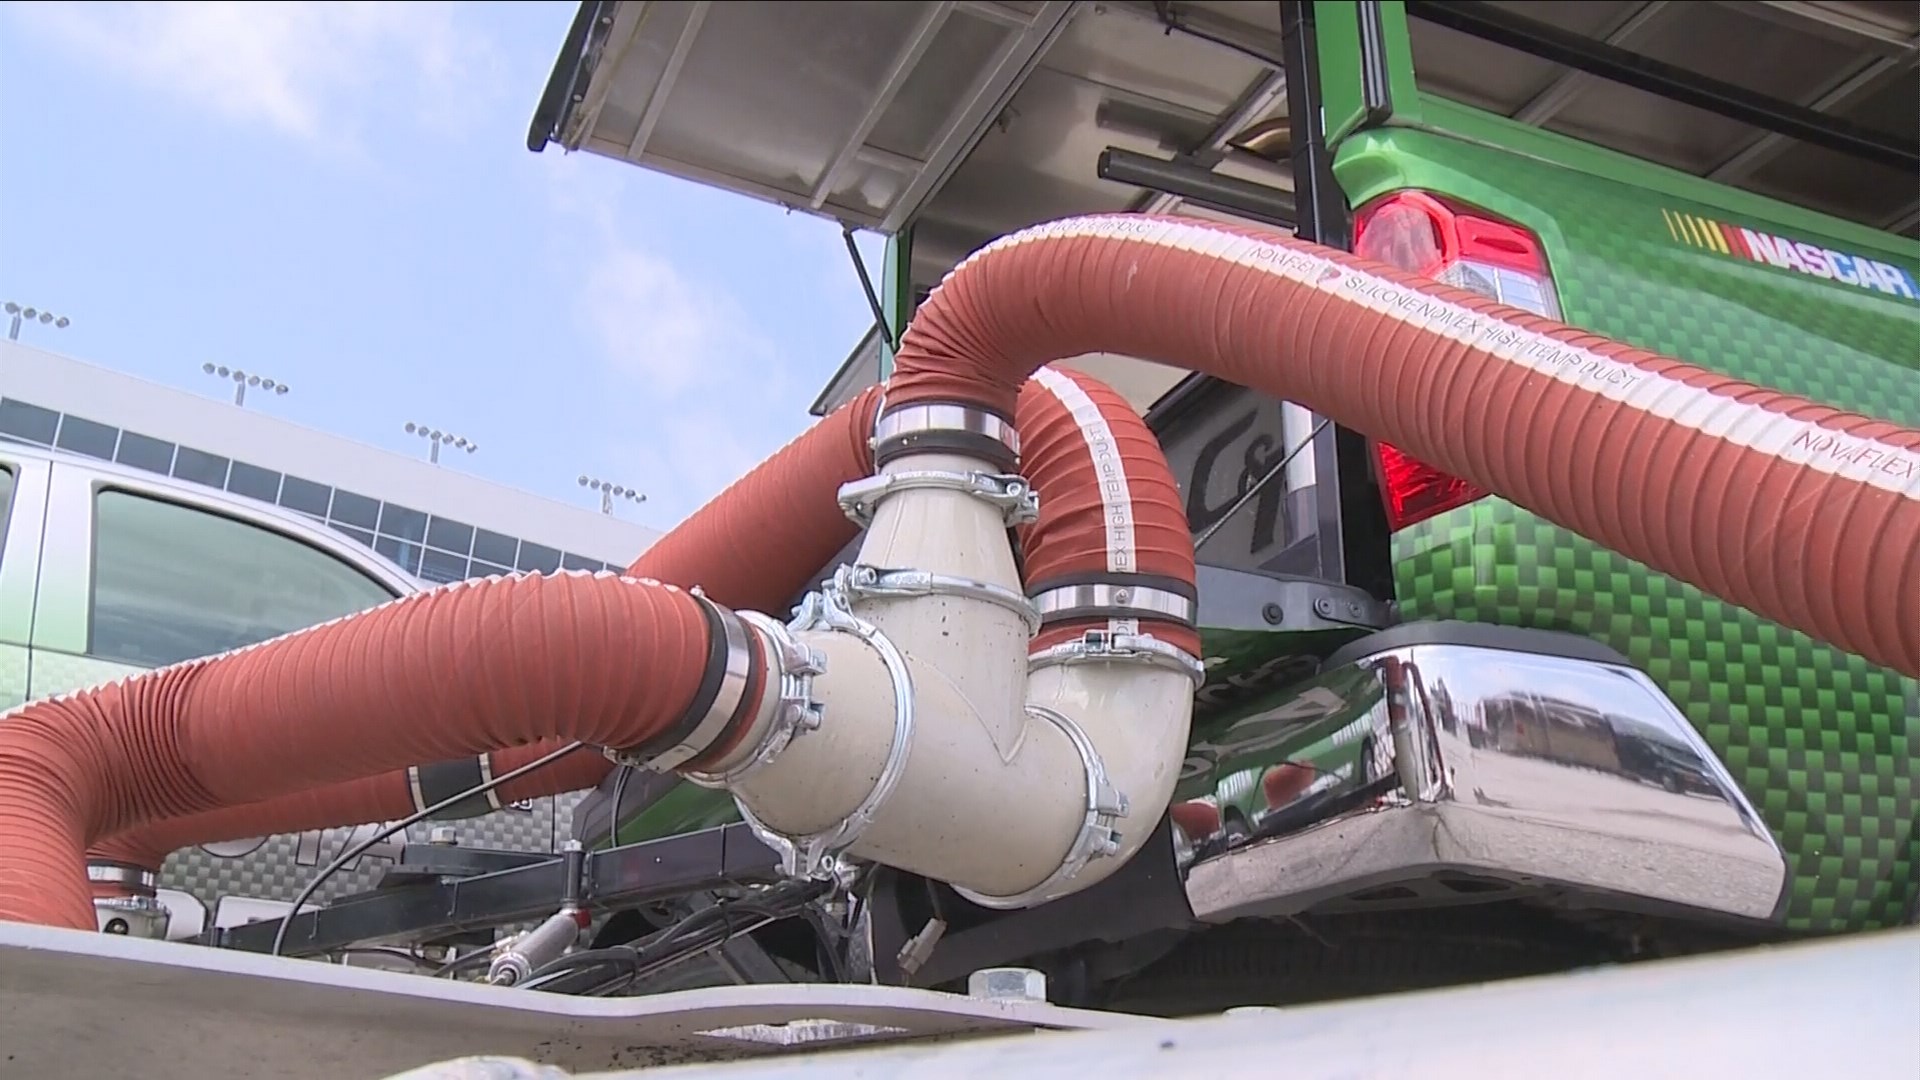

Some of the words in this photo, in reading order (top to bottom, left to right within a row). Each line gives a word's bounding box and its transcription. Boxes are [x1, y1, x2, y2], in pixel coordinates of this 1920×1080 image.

[1740, 227, 1914, 299] NASCAR
[1417, 302, 1484, 335] NOMEX
[1485, 327, 1525, 349] HIGH
[1528, 341, 1582, 366] TEMP
[1578, 361, 1641, 389] DUCT
[1792, 430, 1919, 478] NOVAFLEX
[1102, 463, 1121, 501] TEMP
[1112, 504, 1126, 542] HIGH
